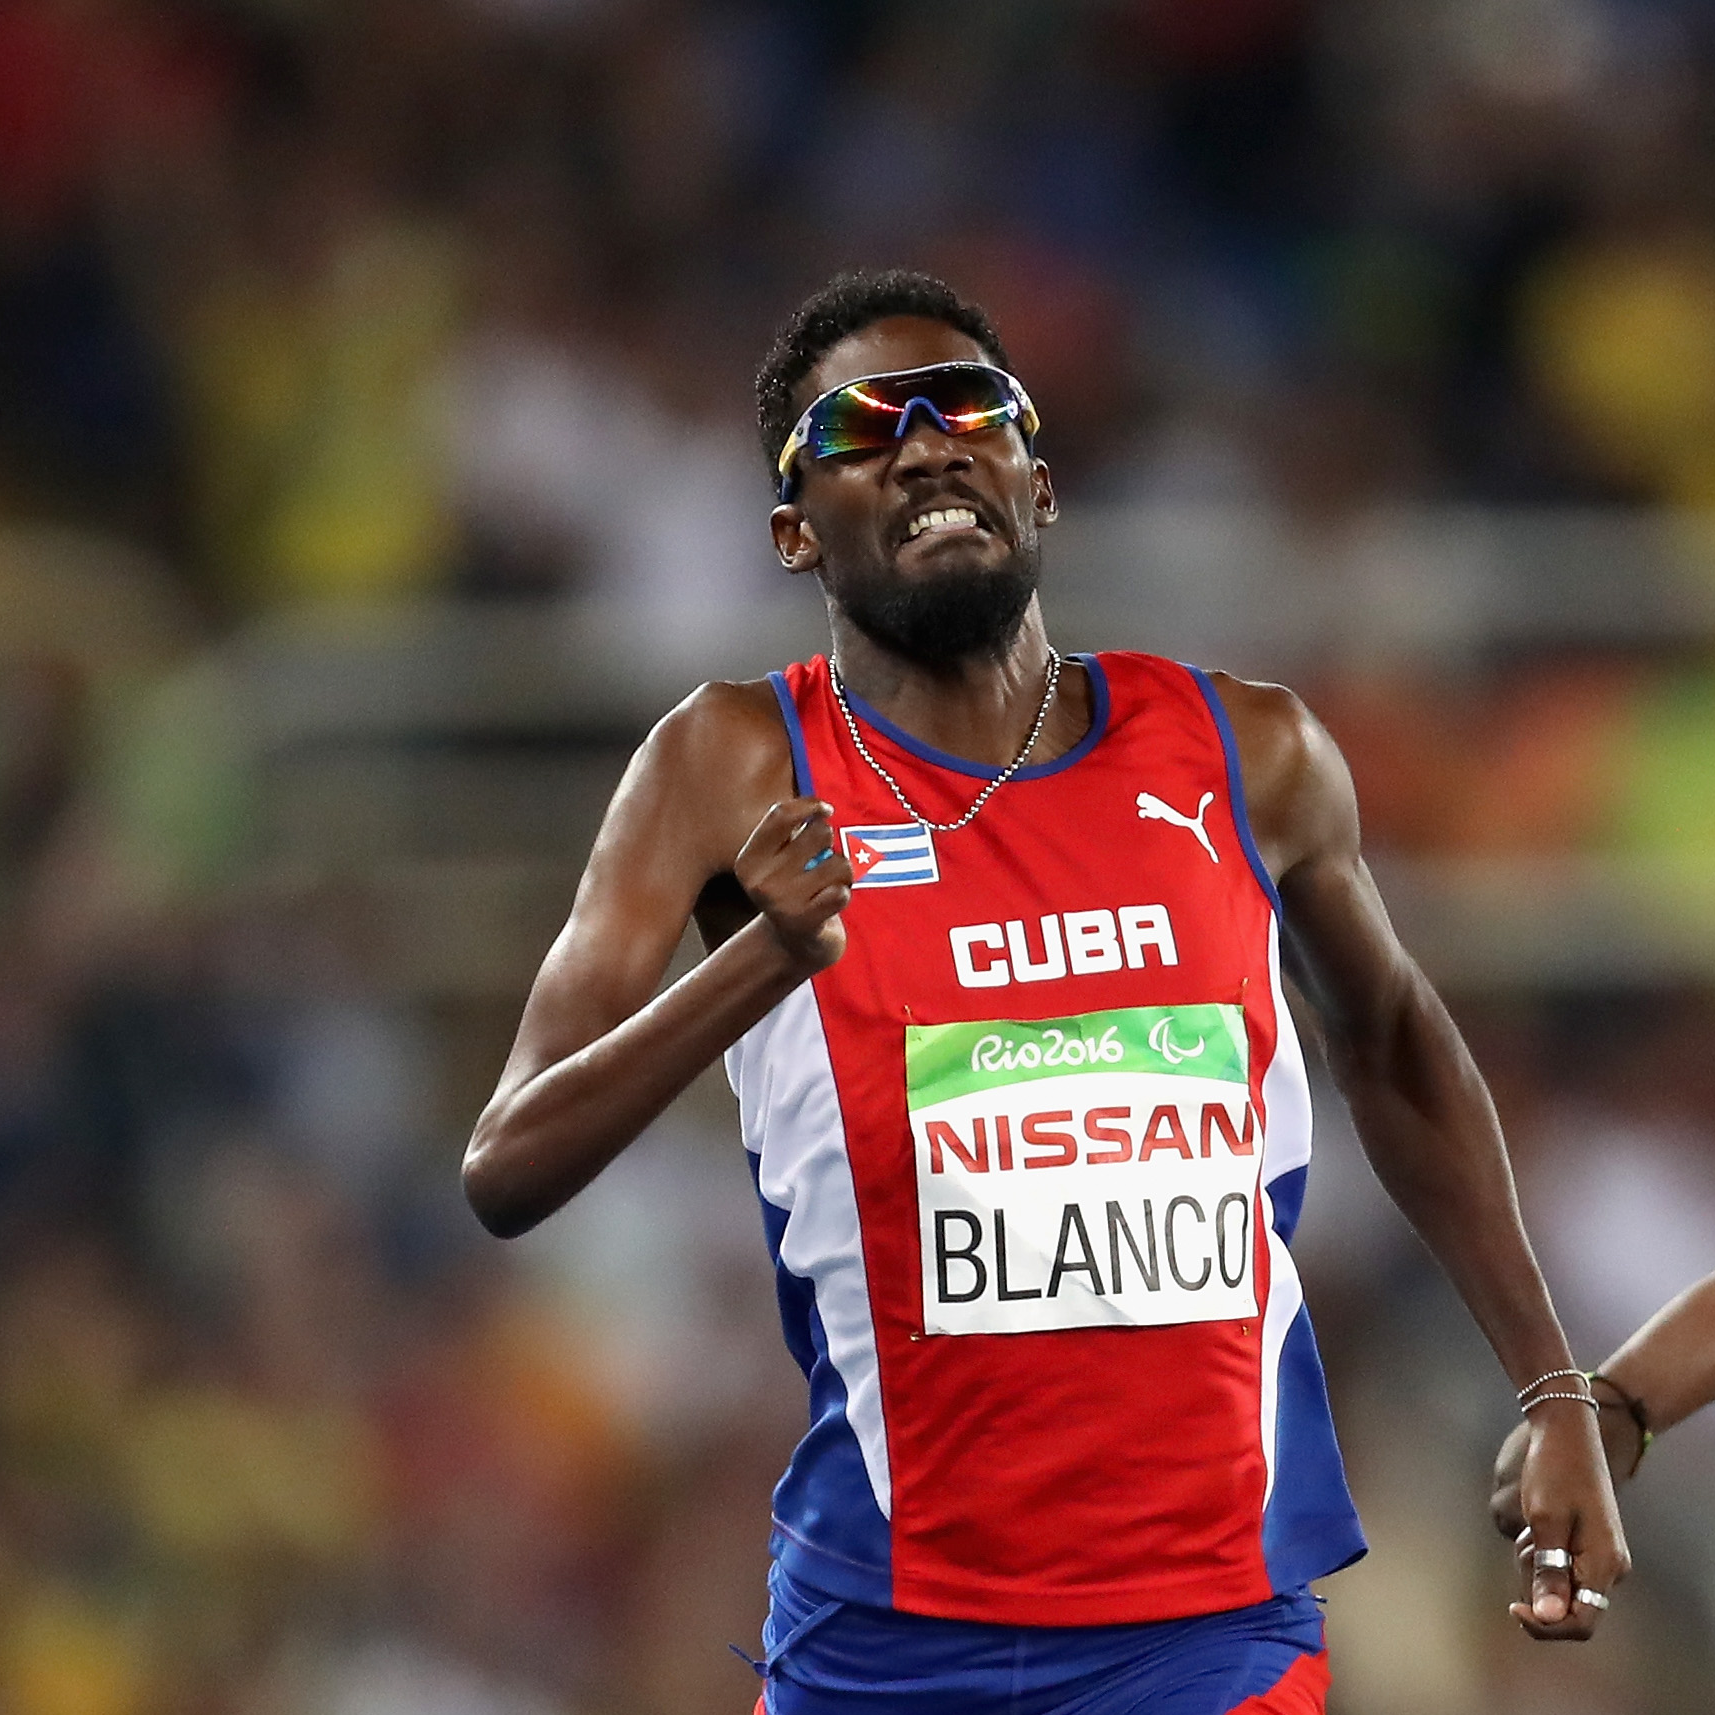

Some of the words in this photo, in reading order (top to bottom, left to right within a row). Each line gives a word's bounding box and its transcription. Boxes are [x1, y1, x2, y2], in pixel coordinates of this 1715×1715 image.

[949, 904, 1179, 989] CUBA
[924, 1101, 1255, 1175] NISSAN
[933, 1192, 1250, 1304] BLANCO
